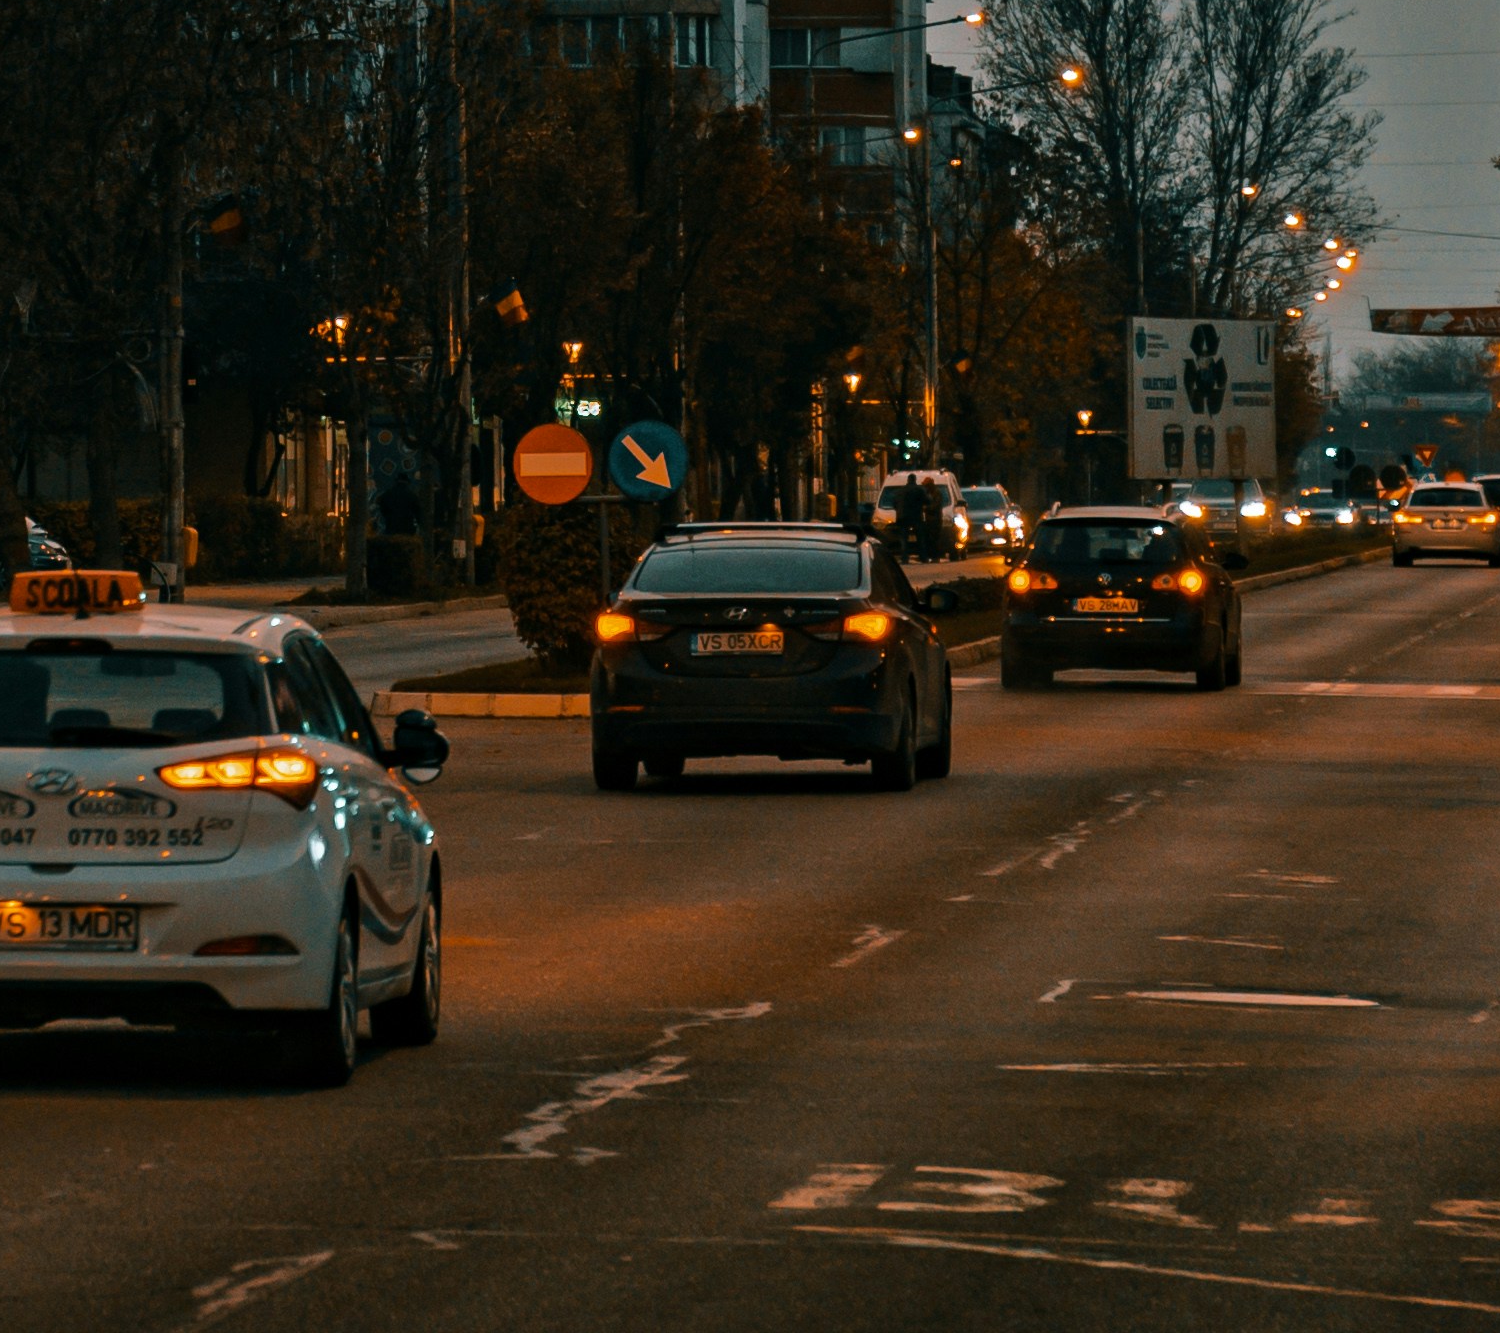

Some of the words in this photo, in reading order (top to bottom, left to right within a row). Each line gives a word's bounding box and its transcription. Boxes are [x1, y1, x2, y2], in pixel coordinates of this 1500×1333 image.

[700, 635, 722, 650] VS
[727, 634, 782, 650] 05XCR
[80, 800, 157, 815] MACDRIVE
[0, 828, 36, 846] 047
[68, 828, 117, 846] 0770
[125, 828, 160, 846] 392
[167, 828, 203, 846] 552
[40, 910, 63, 937] 13
[69, 909, 133, 938] MDR
